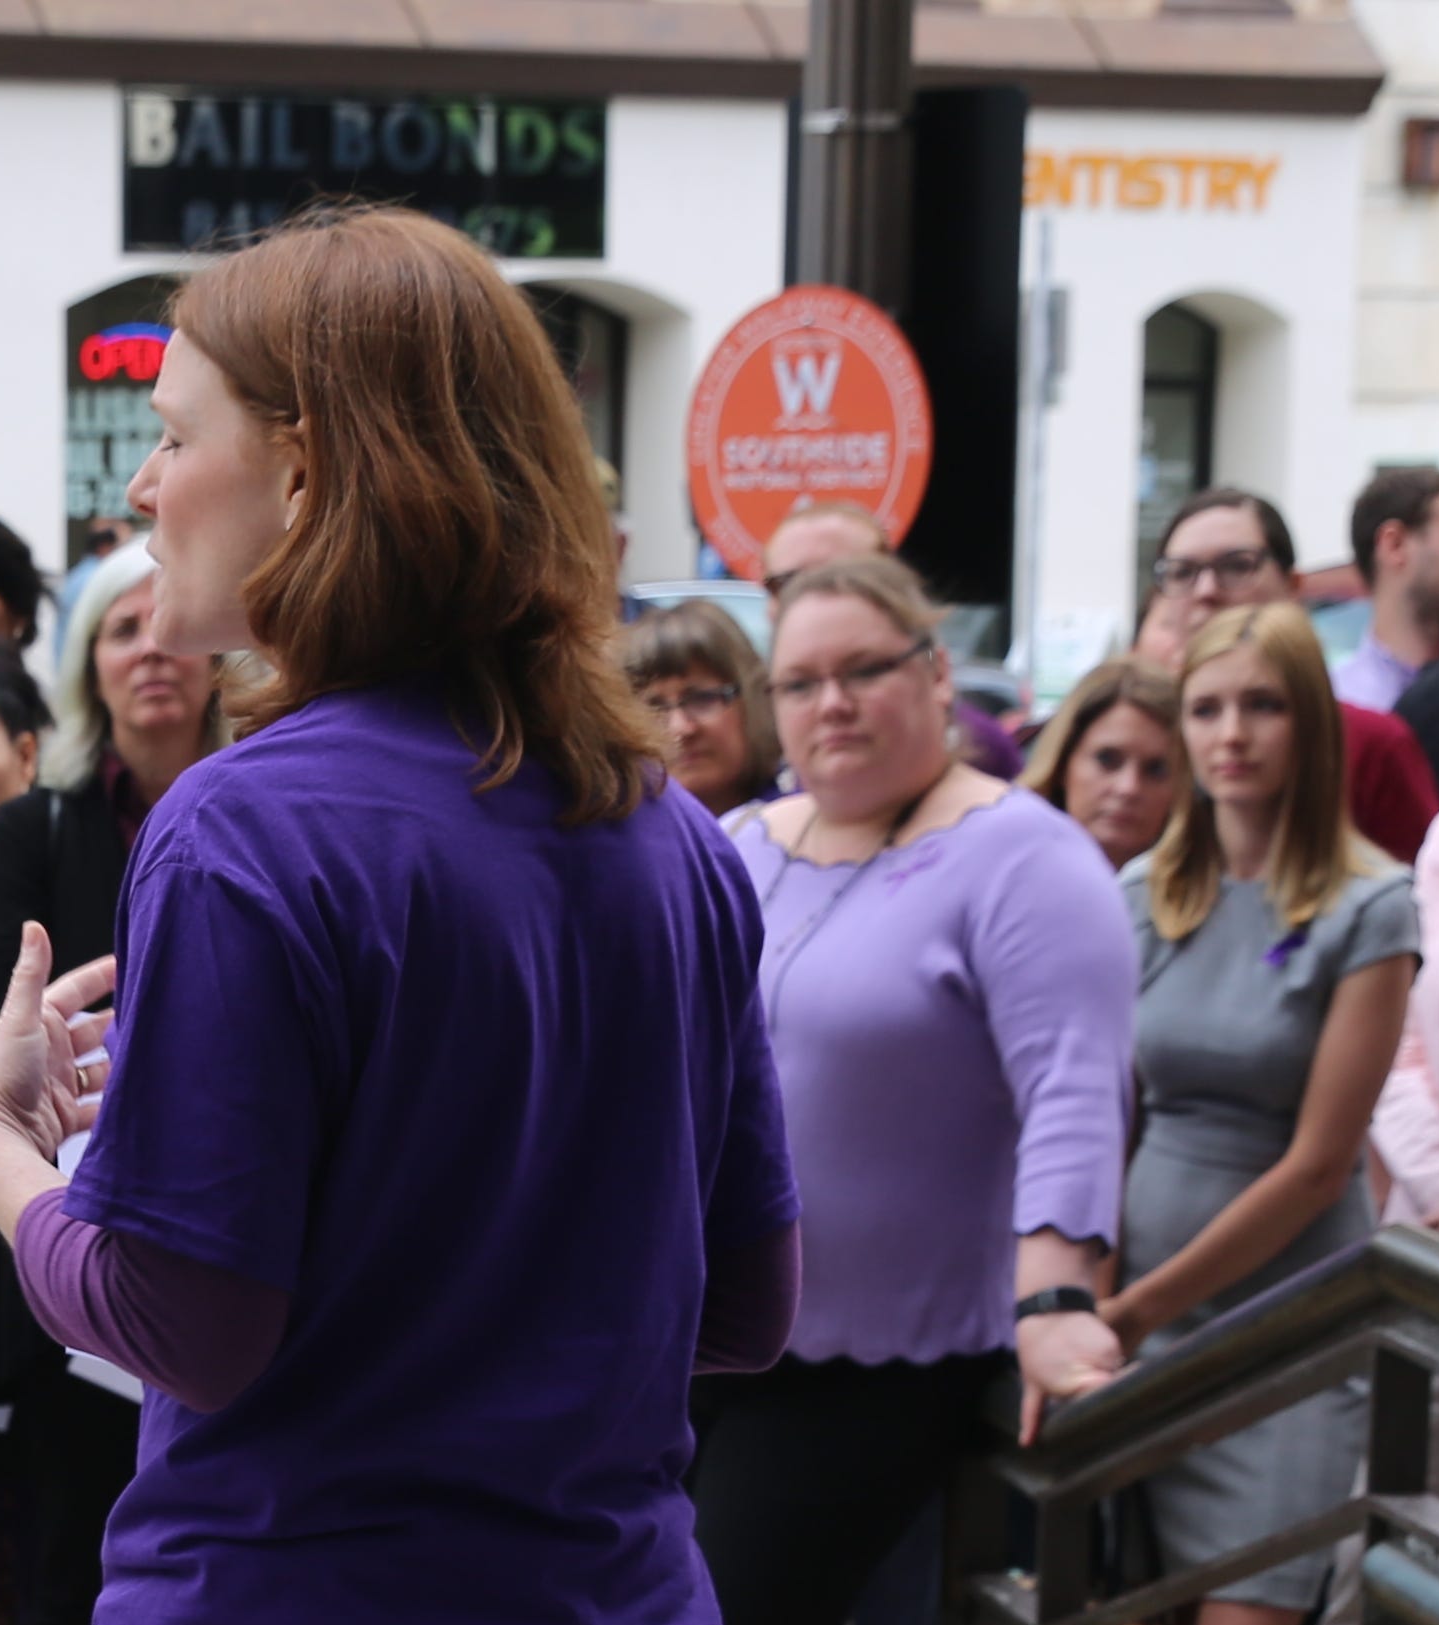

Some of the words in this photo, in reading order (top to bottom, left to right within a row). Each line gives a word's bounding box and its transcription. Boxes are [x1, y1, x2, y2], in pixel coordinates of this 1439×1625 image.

[128, 92, 307, 170] BAIL
[332, 96, 602, 175] BONDS
[771, 350, 843, 418] W
[724, 433, 890, 469] SOUTHSIDE
